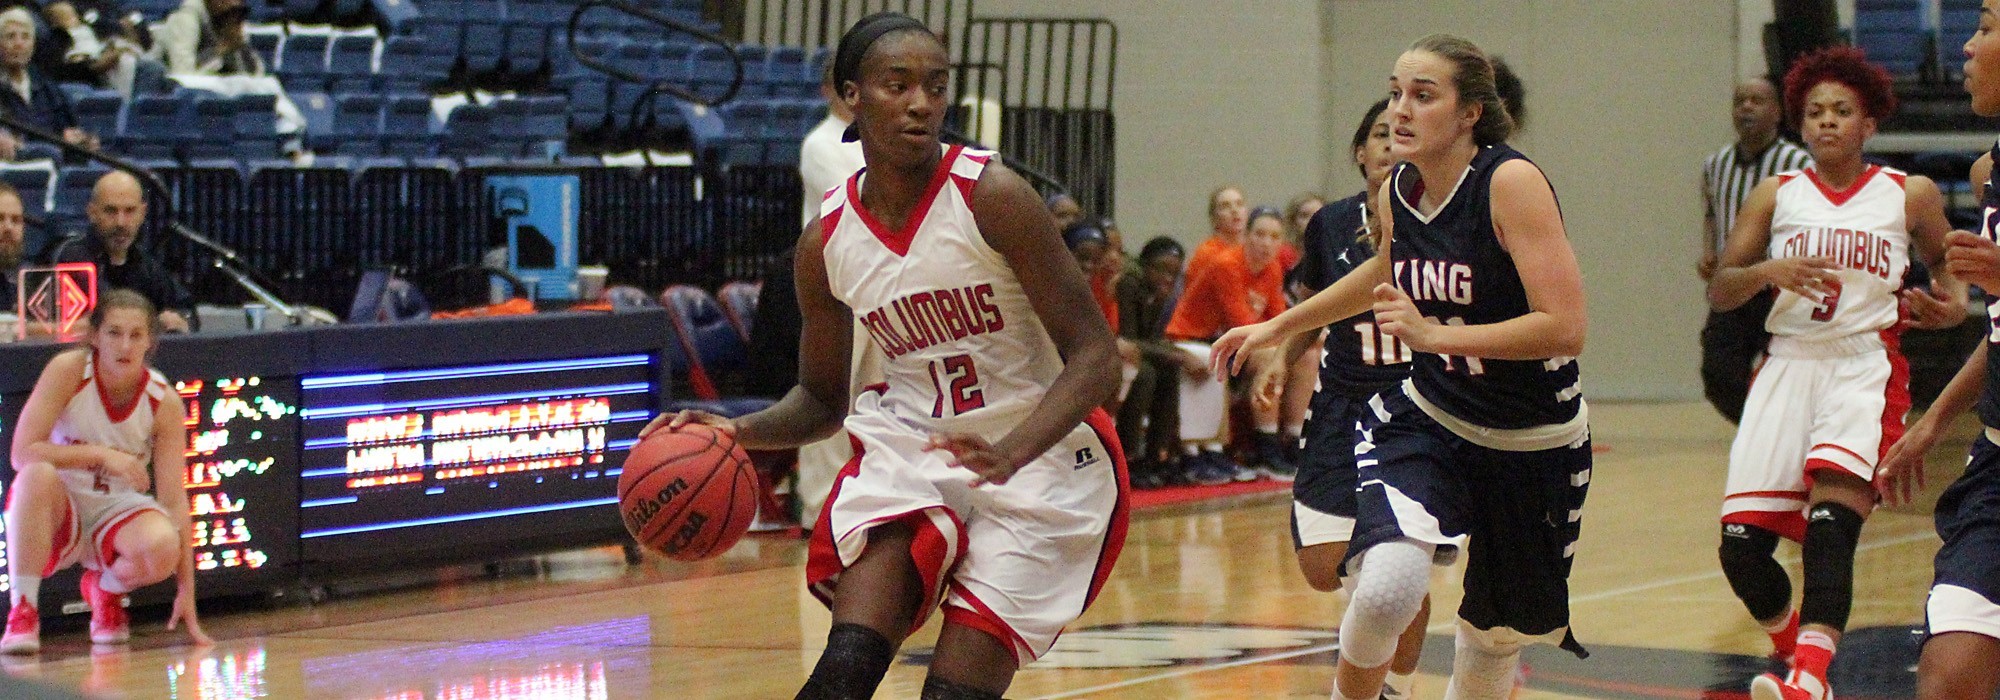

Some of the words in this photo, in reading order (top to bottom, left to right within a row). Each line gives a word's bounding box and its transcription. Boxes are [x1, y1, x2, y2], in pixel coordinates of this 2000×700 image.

[1394, 258, 1472, 305] KING
[860, 283, 1004, 360] COLUMBUS
[928, 354, 985, 418] 12
